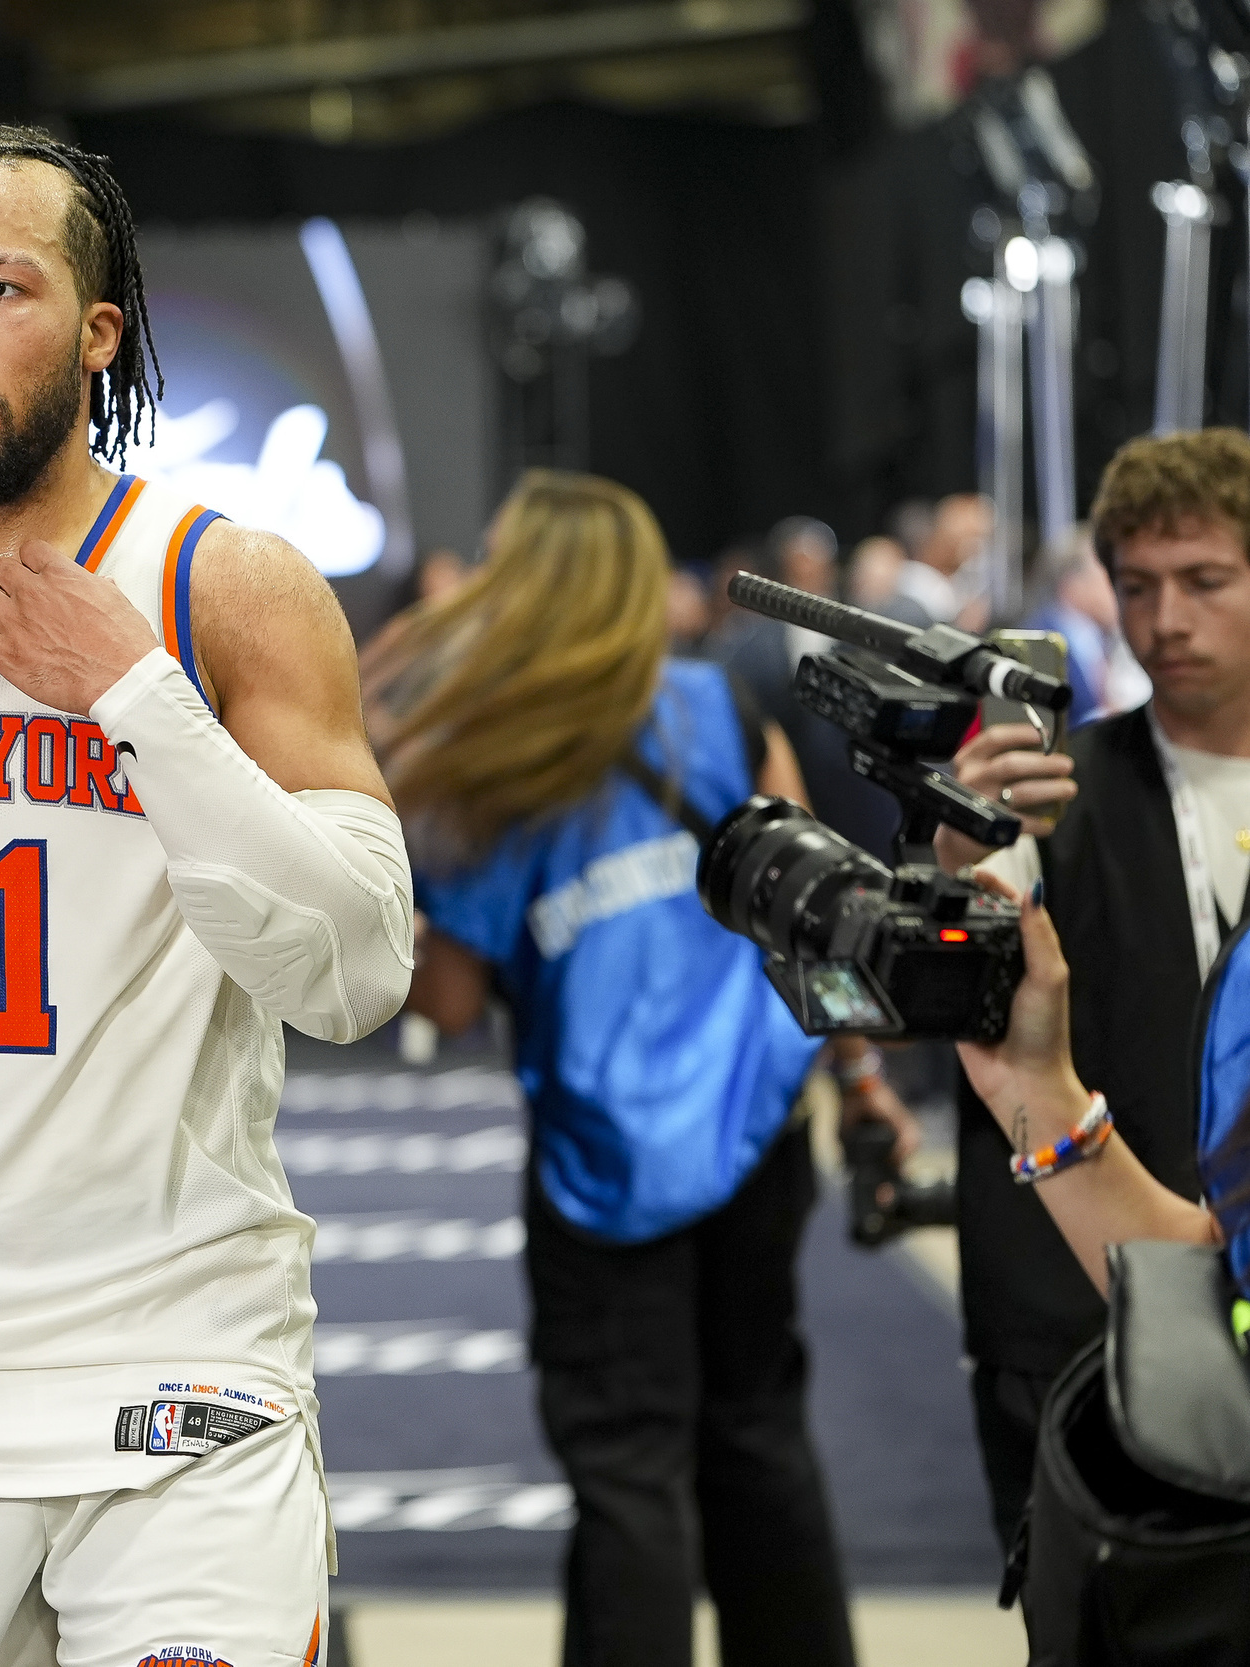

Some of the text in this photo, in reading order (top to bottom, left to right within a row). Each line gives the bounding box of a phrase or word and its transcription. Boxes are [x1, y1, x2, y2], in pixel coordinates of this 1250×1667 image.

[158, 1382, 183, 1392] ONCE
[184, 1383, 191, 1392] A
[223, 1388, 256, 1404] ALWAYS
[187, 1416, 202, 1426] 48
[210, 1410, 258, 1425] ENGINEERED
[153, 1438, 164, 1449] NBA
[159, 1646, 183, 1659] NEW
[186, 1646, 213, 1661] YORK
